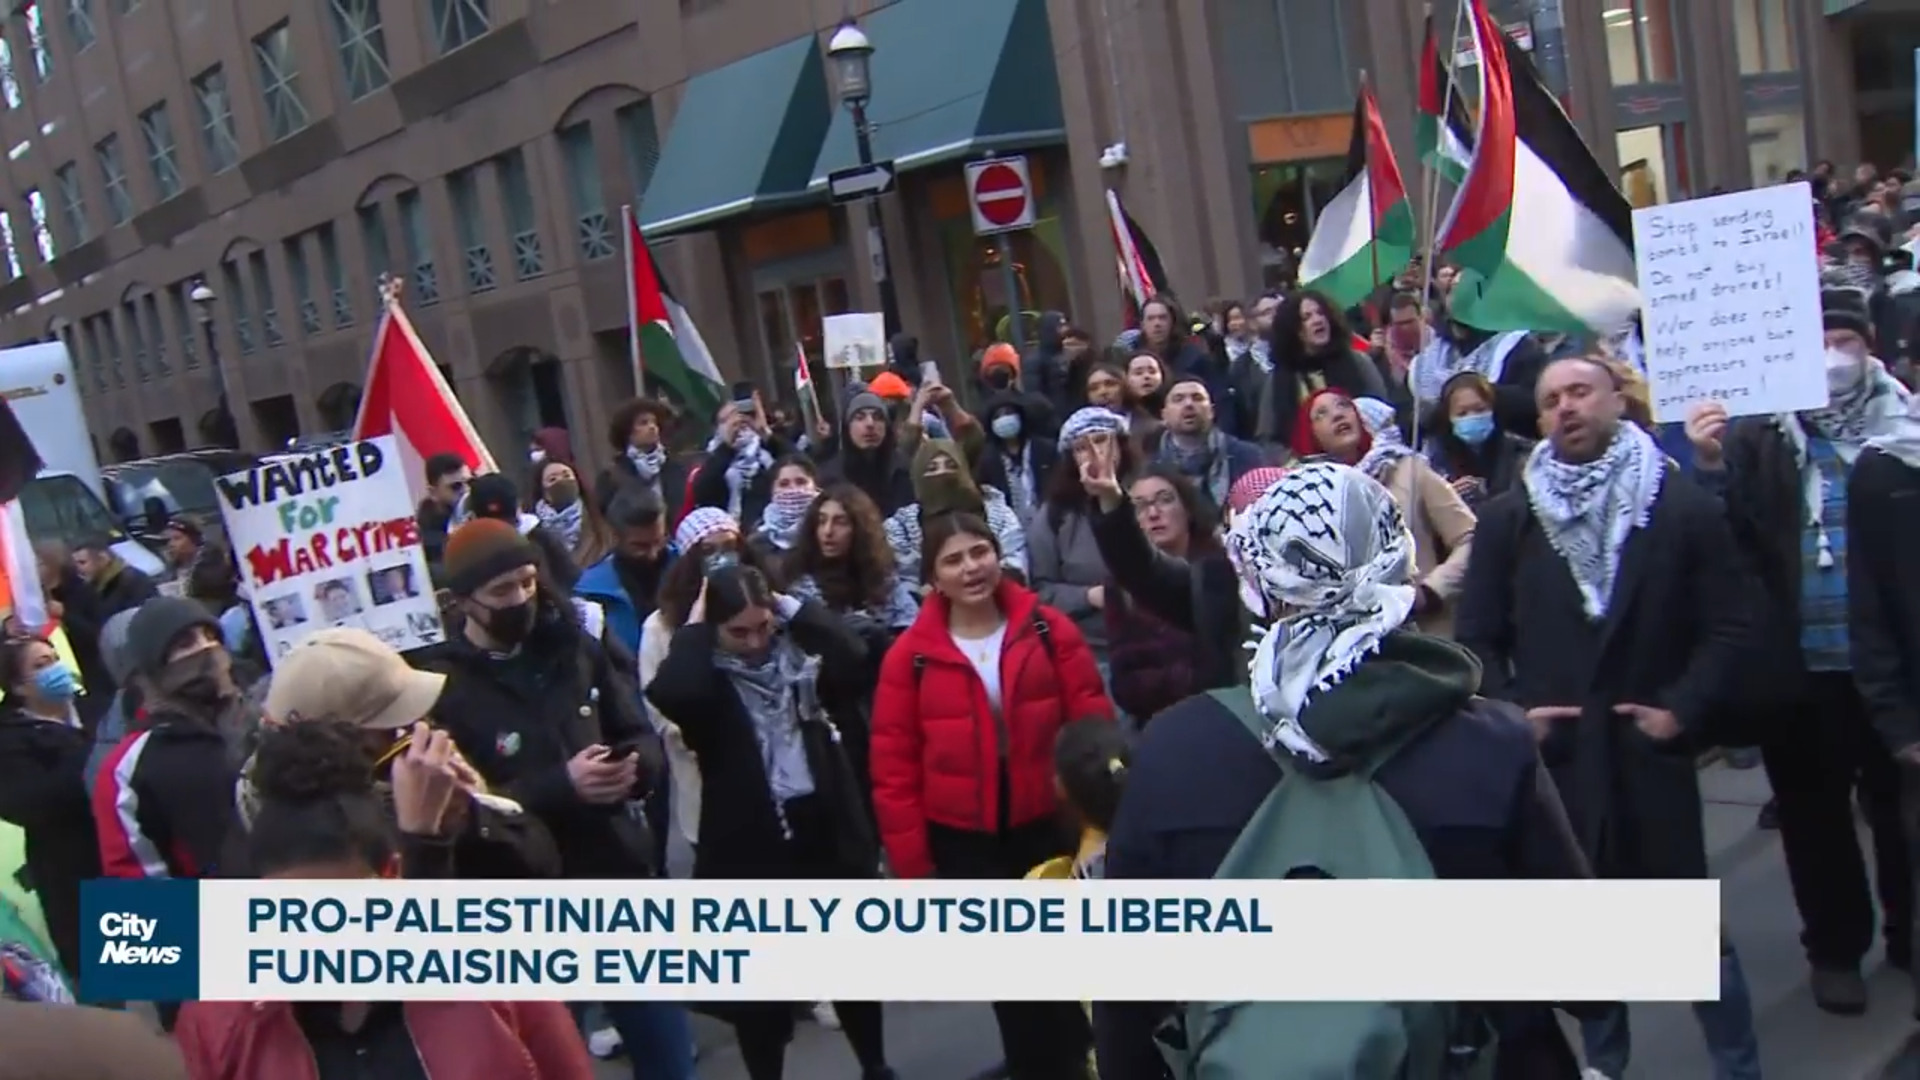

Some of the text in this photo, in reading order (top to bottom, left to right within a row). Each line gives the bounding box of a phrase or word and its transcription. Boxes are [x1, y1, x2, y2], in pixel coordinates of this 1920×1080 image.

[1649, 208, 1774, 243] Stop sending
[1712, 238, 1728, 248] to
[1650, 260, 1766, 286] Do not buy
[1656, 305, 1792, 336] War does not
[1655, 328, 1794, 361] help anyone but
[1763, 348, 1795, 364] and
